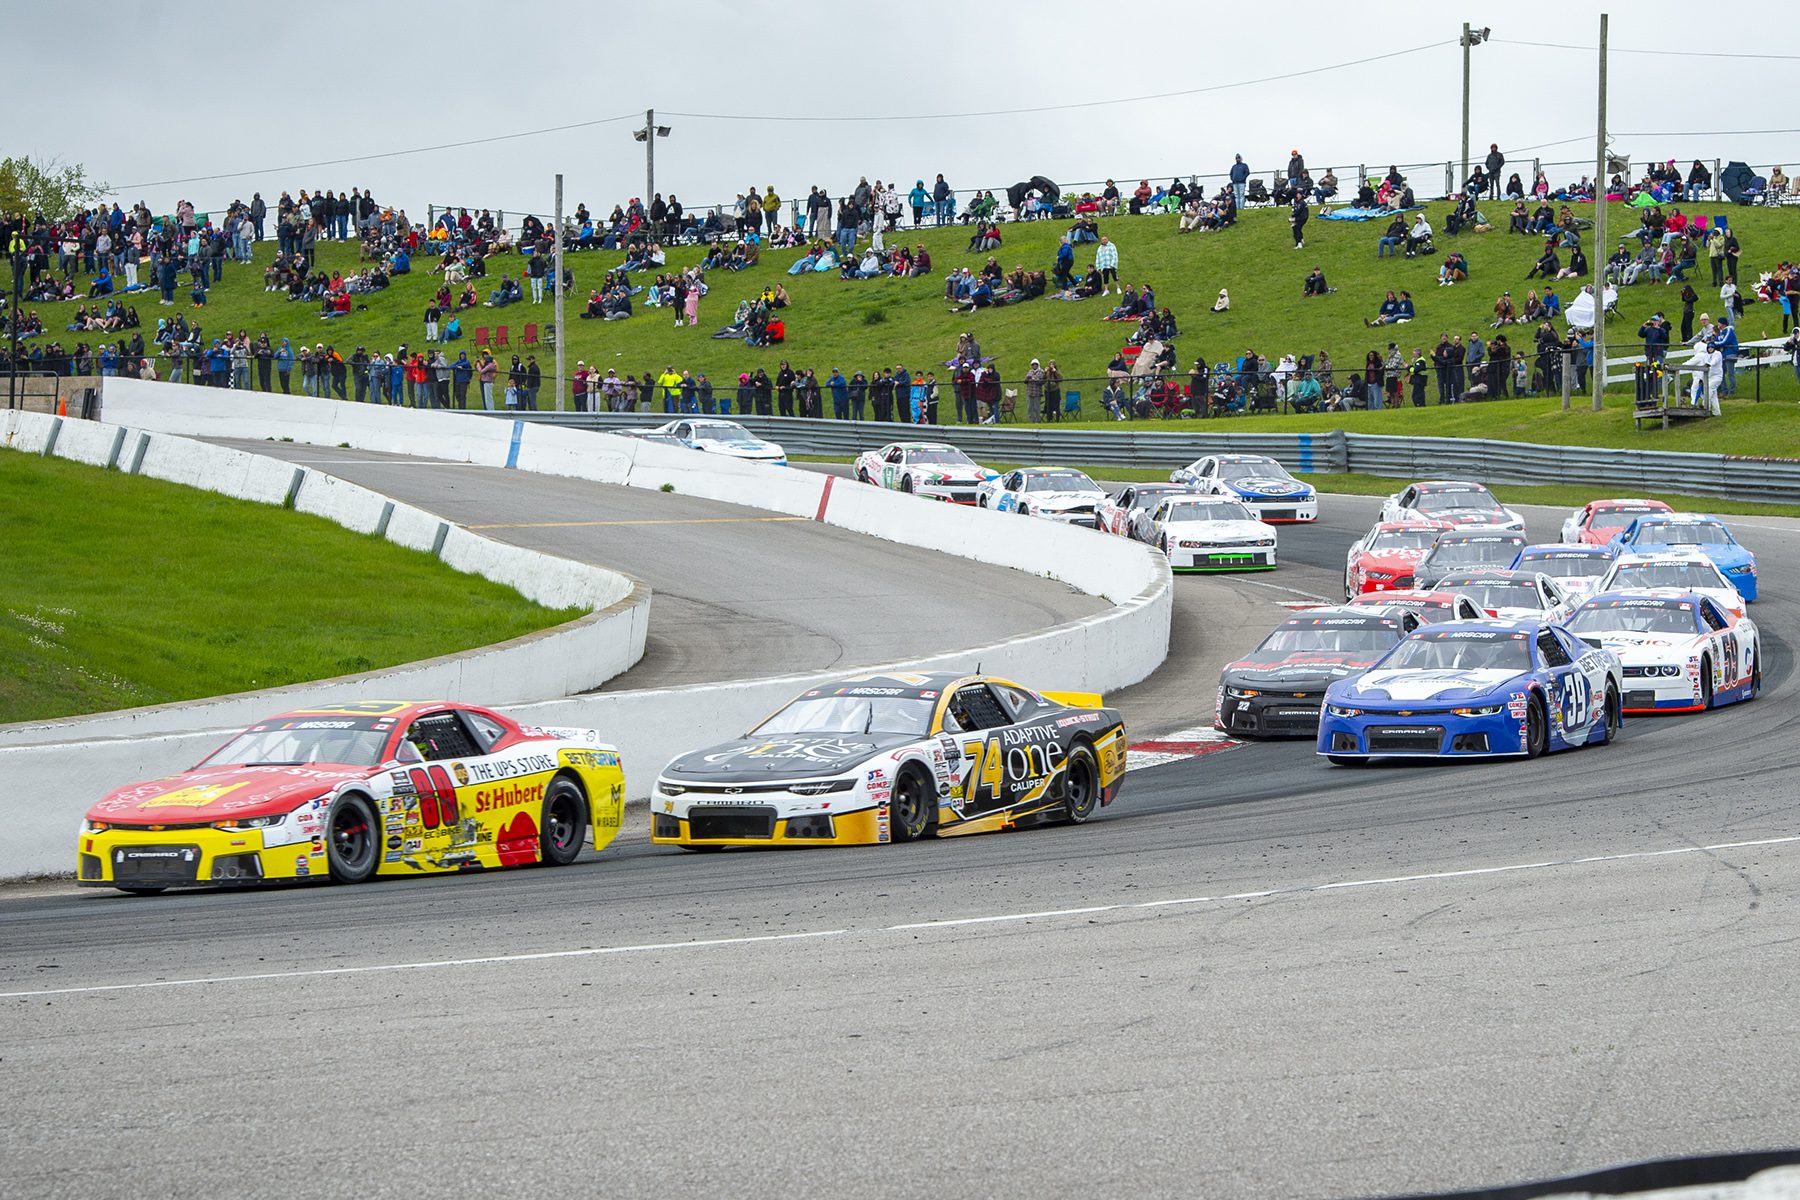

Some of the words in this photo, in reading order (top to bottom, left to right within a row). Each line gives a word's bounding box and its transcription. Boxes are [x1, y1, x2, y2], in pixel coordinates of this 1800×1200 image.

[1451, 631, 1496, 639] NASCAR
[849, 687, 904, 696] NASCAR
[1565, 671, 1585, 728] 39
[1237, 701, 1250, 711] 22
[297, 721, 356, 730] NASCAR
[1003, 724, 1060, 746] ADAPTIVE
[470, 763, 494, 780] THE
[493, 760, 518, 777] UPS
[518, 754, 556, 773] STORE
[1007, 741, 1064, 780] one
[963, 737, 1003, 804] 74
[1010, 778, 1046, 793] CALIPER
[475, 790, 490, 813] St
[492, 782, 544, 810] Hubert
[664, 801, 673, 813] 74
